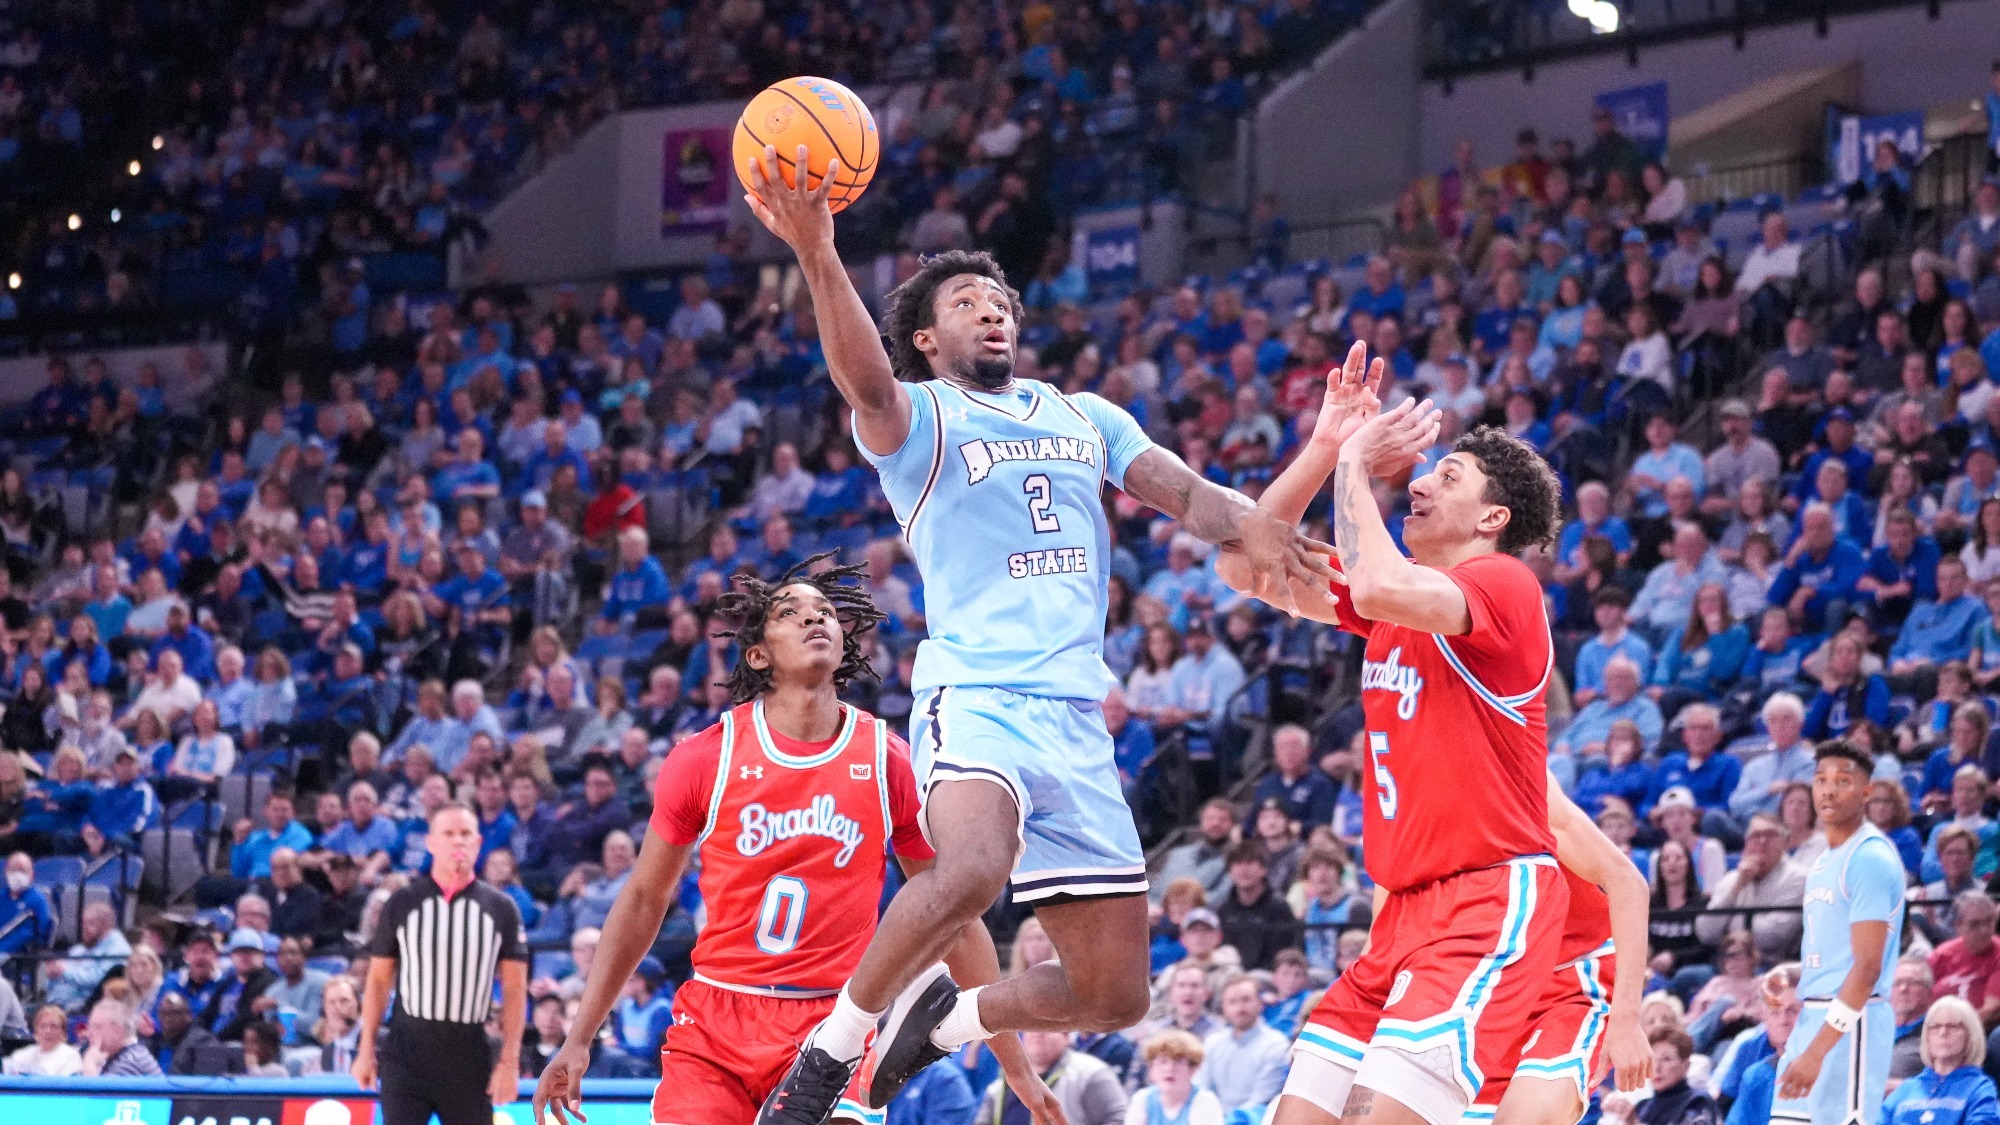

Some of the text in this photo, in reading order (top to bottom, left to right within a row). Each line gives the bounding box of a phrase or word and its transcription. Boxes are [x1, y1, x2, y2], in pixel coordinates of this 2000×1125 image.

[1023, 473, 1061, 534] 2
[1008, 547, 1087, 579] STATE
[1362, 646, 1424, 720] radley
[1368, 731, 1398, 820] 5
[736, 794, 864, 868] Bradley
[754, 875, 809, 954] 0
